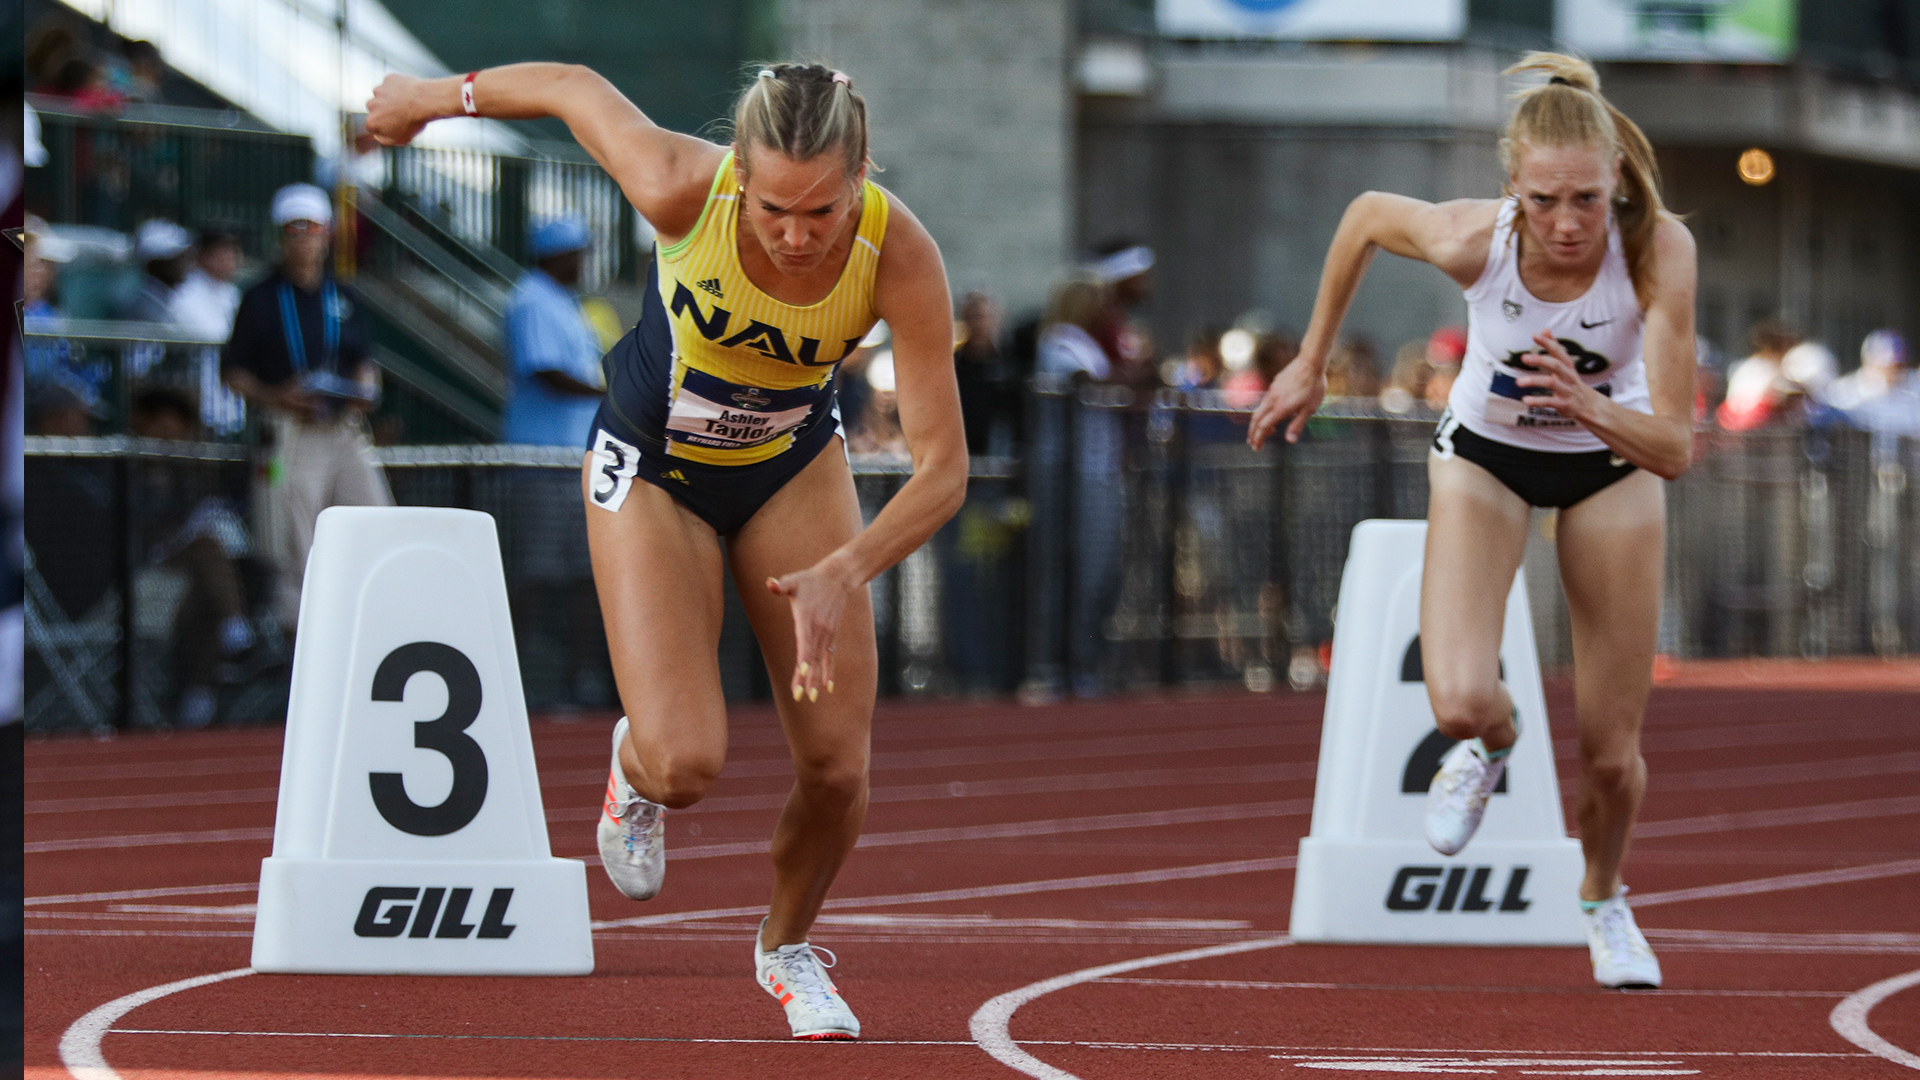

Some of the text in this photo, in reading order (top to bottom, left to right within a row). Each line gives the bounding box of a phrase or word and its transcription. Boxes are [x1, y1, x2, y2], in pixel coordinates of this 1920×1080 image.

[670, 278, 865, 367] NAU
[705, 419, 775, 440] Taylor
[719, 410, 771, 426] Ashley
[594, 440, 625, 504] 3
[369, 641, 489, 837] 3
[354, 886, 517, 939] GILL
[1384, 866, 1532, 912] GILL
